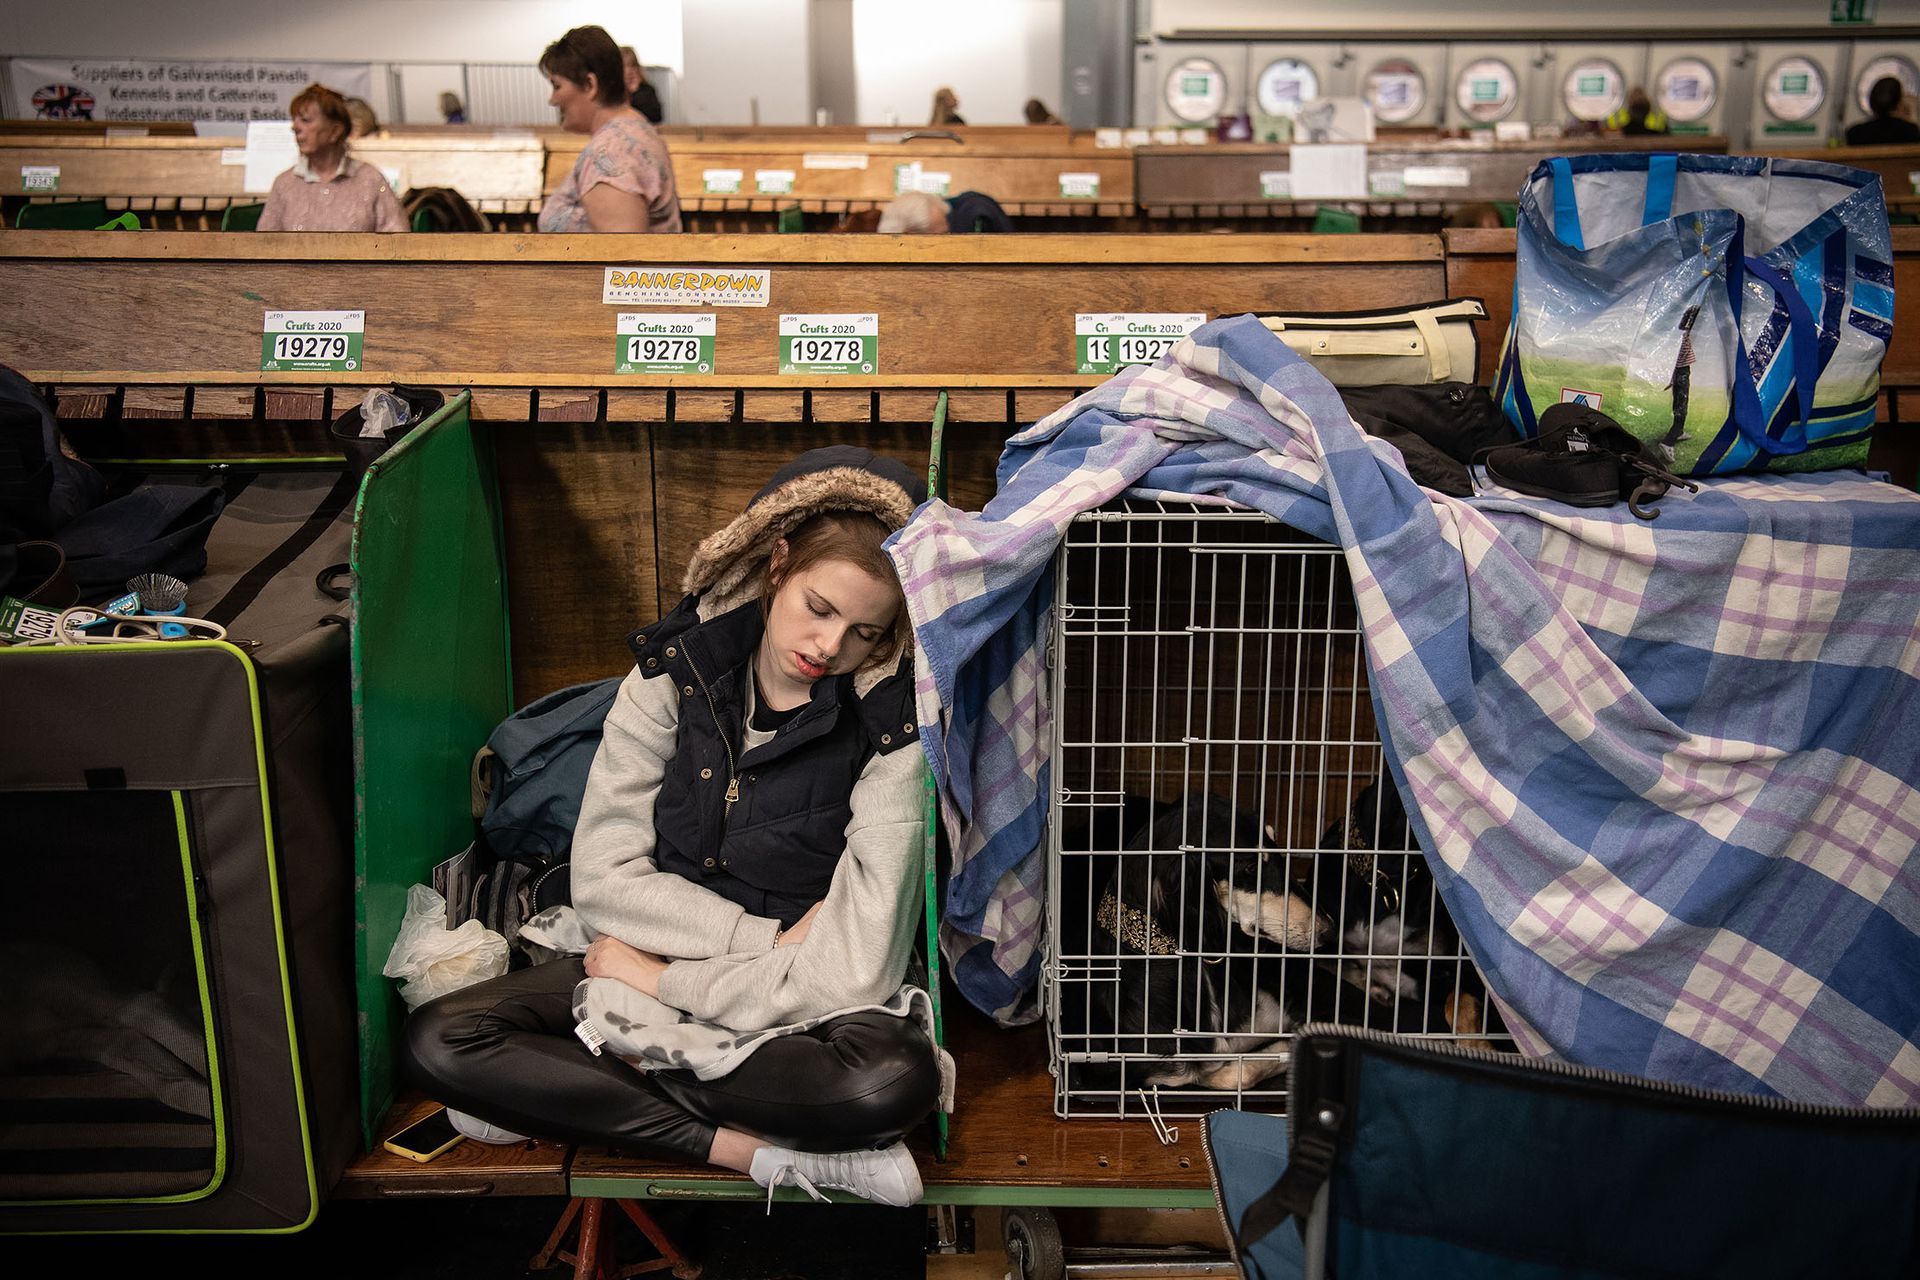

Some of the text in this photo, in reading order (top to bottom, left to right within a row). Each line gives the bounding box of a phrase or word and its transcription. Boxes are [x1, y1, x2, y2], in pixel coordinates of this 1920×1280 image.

[72, 65, 309, 83] Suppliers of Galvanised Panels
[110, 86, 278, 102] Kennels and Catteries
[609, 271, 764, 292] BANNERDOWN
[286, 320, 315, 330] Crufts
[638, 323, 693, 333] Crufts 2020
[800, 323, 829, 333] Crufts
[1128, 323, 1182, 333] Crufts 2020
[278, 337, 346, 358] 19279
[631, 340, 697, 360] 19278
[794, 340, 859, 361] 19278
[18, 610, 57, 639] 19279
